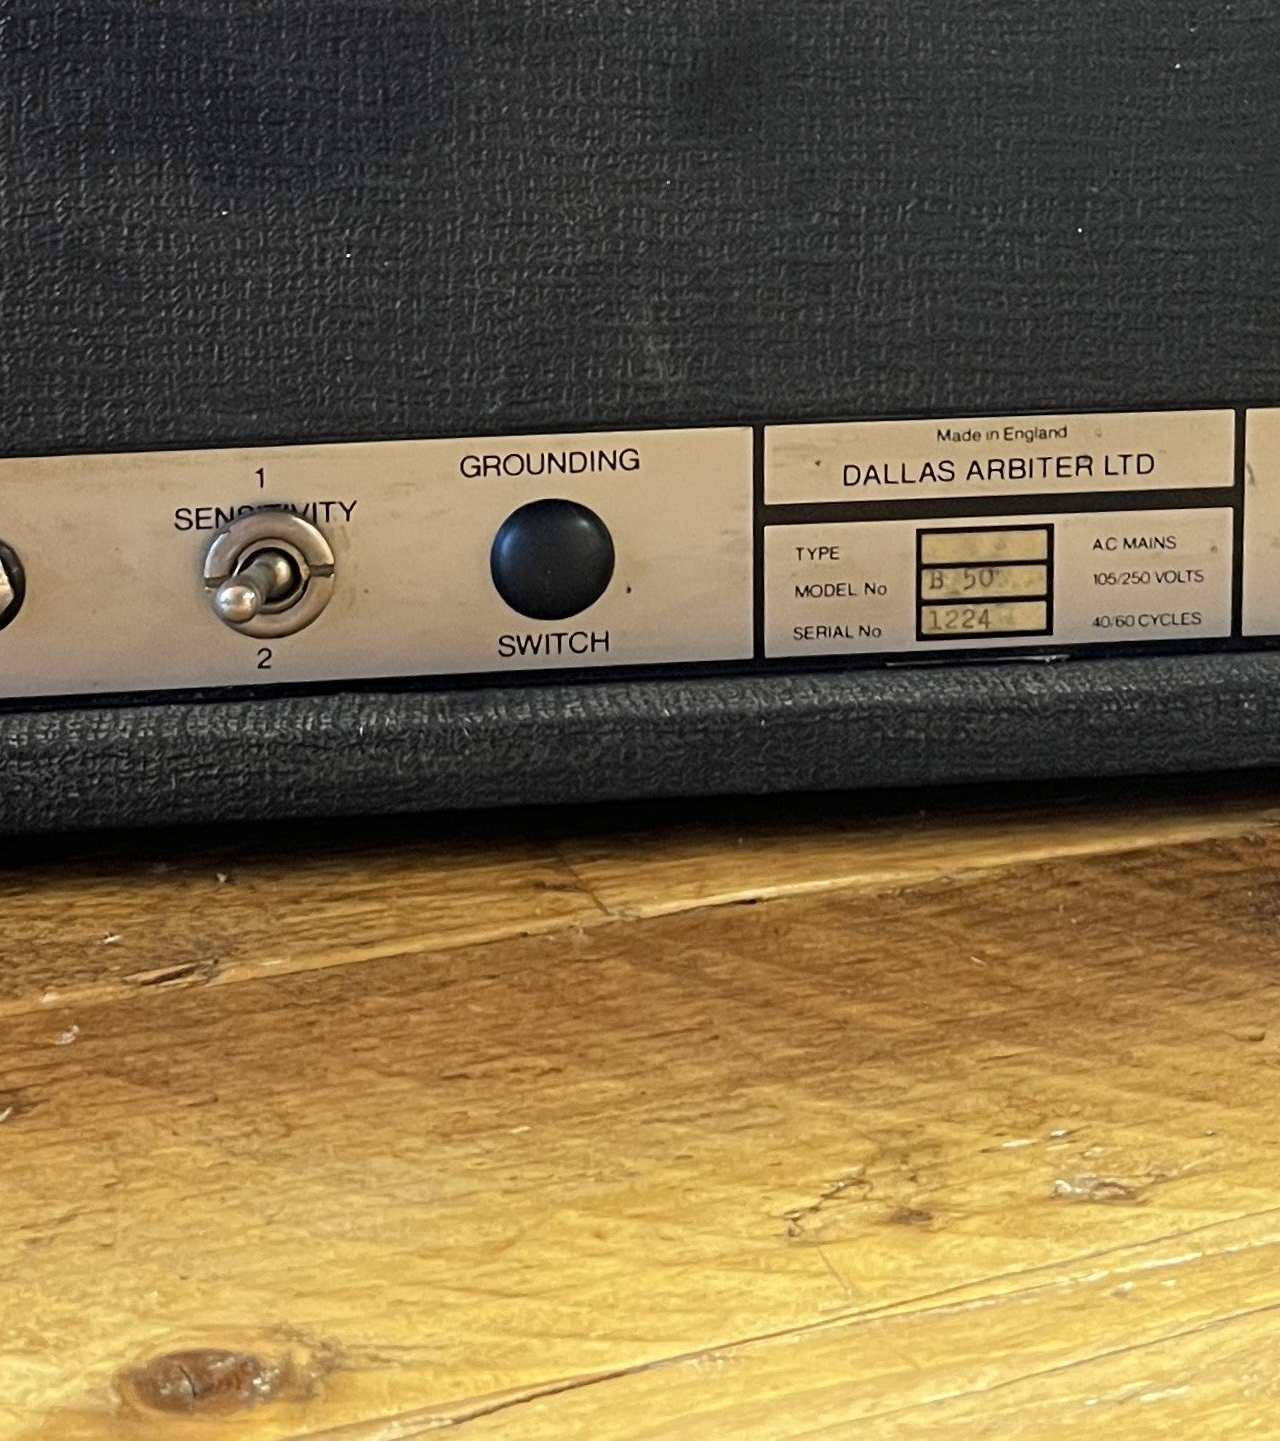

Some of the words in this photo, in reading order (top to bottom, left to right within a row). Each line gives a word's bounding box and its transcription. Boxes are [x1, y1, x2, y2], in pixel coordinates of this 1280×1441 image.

[936, 428, 982, 443] Made
[986, 428, 1000, 442] in
[1004, 426, 1068, 444] England
[460, 448, 640, 478] GROUNDING
[843, 459, 956, 486] DALLAS
[965, 455, 1094, 481] ARBITER
[1104, 453, 1155, 476] LTD
[255, 467, 265, 488] 1
[1092, 536, 1118, 551] AC
[1123, 535, 1177, 550] MAINS
[795, 545, 840, 561] TYPE
[929, 568, 944, 590] B
[1093, 570, 1151, 586] 105/250
[1155, 569, 1205, 584] VOLTS
[795, 582, 857, 598] MODEL
[864, 582, 887, 596] No
[928, 608, 991, 631] 1224
[1138, 612, 1202, 627] CYCLES
[793, 625, 854, 640] SERIAL
[859, 625, 882, 638] No
[498, 630, 609, 658] SWITCH
[256, 648, 273, 670] 2
